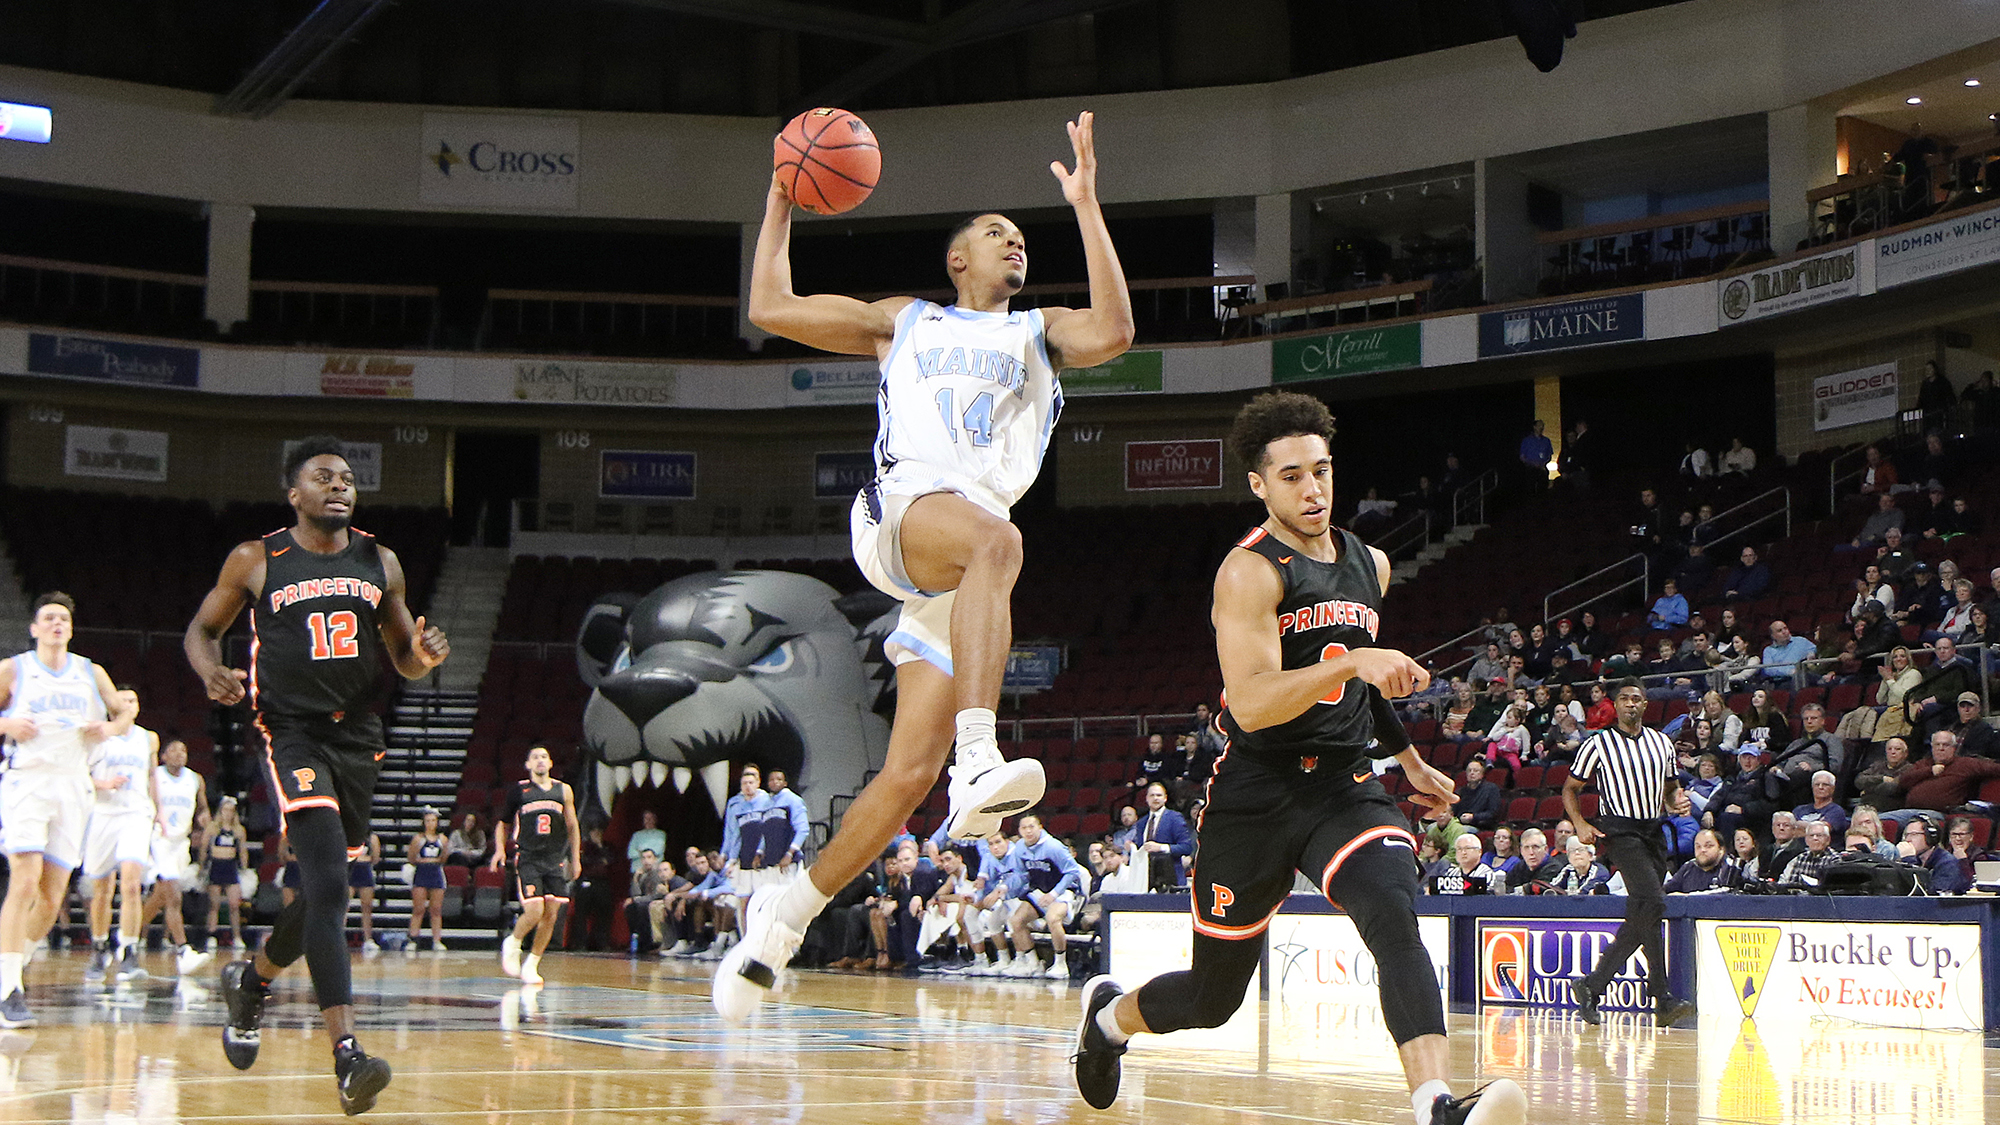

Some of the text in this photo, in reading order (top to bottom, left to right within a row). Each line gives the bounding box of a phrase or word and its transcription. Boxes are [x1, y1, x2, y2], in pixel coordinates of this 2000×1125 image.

[1881, 230, 1943, 257] RUDMAN
[1533, 309, 1619, 341] MAINE
[1301, 331, 1383, 372] Merrill
[914, 347, 1029, 401] MAINE
[935, 387, 994, 448] 14
[395, 426, 429, 443] 109
[556, 430, 591, 449] 108
[1135, 457, 1213, 472] INFINITY
[271, 577, 383, 613] PRINCETON
[308, 610, 359, 660] 12
[1278, 600, 1380, 643] PRINCETON
[292, 767, 317, 792] P
[537, 813, 552, 835] 2
[1437, 876, 1464, 890] POSS
[1211, 882, 1235, 918] P
[1728, 931, 1768, 945] SURVIVE
[1735, 948, 1761, 959] YOUR
[1315, 949, 1351, 986] U.S.
[1733, 961, 1764, 973] DRIVE.
[1787, 932, 1961, 979] Buckle Up.
[1798, 976, 1947, 1010] No Excuses!
